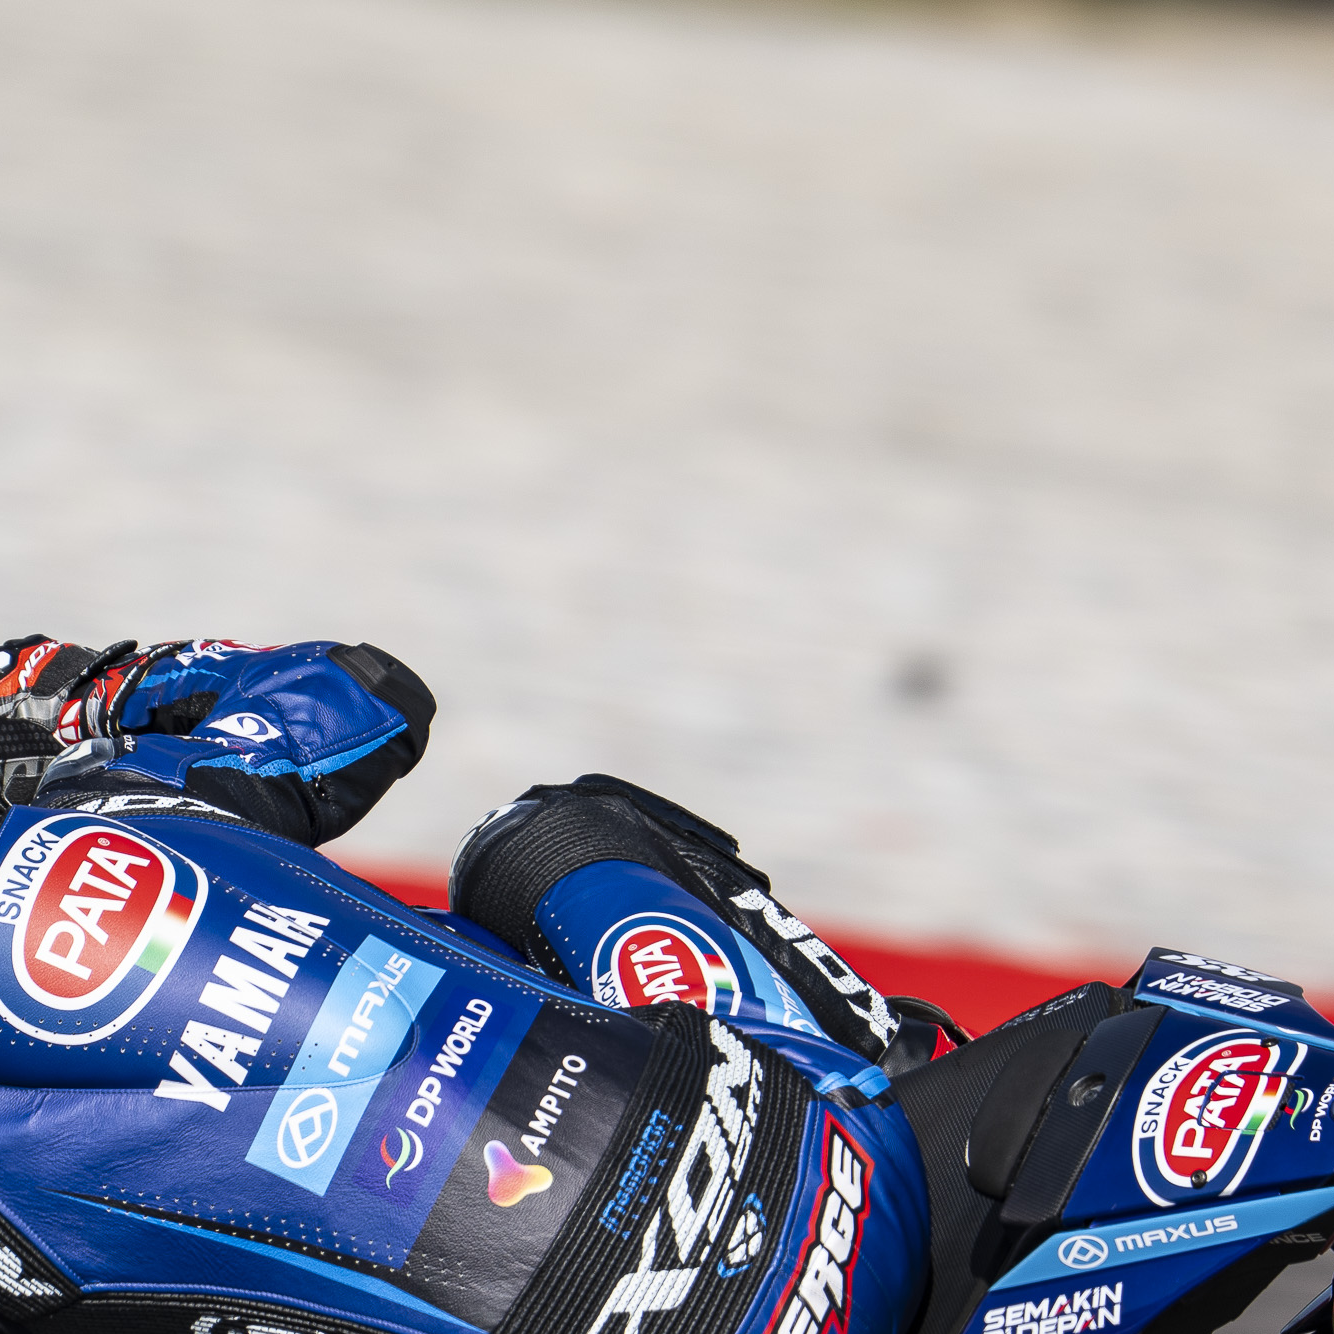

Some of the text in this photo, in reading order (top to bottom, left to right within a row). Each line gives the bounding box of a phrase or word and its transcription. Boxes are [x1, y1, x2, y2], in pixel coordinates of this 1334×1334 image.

[34, 842, 152, 981] PATA
[153, 902, 331, 1113] YAMAHA
[328, 951, 413, 1077] MAXUS
[597, 973, 621, 1008] ACK
[1147, 977, 1265, 1013] SEMAKIN
[406, 997, 493, 1128] DP WORLD
[525, 1053, 588, 1156] AMPITO
[1140, 1057, 1190, 1135] SNACK
[1171, 1050, 1262, 1160] PATA
[1308, 1117, 1323, 1142] DP
[1114, 1214, 1240, 1253] MAXUS
[983, 1281, 1124, 1331] SEMAKIN
